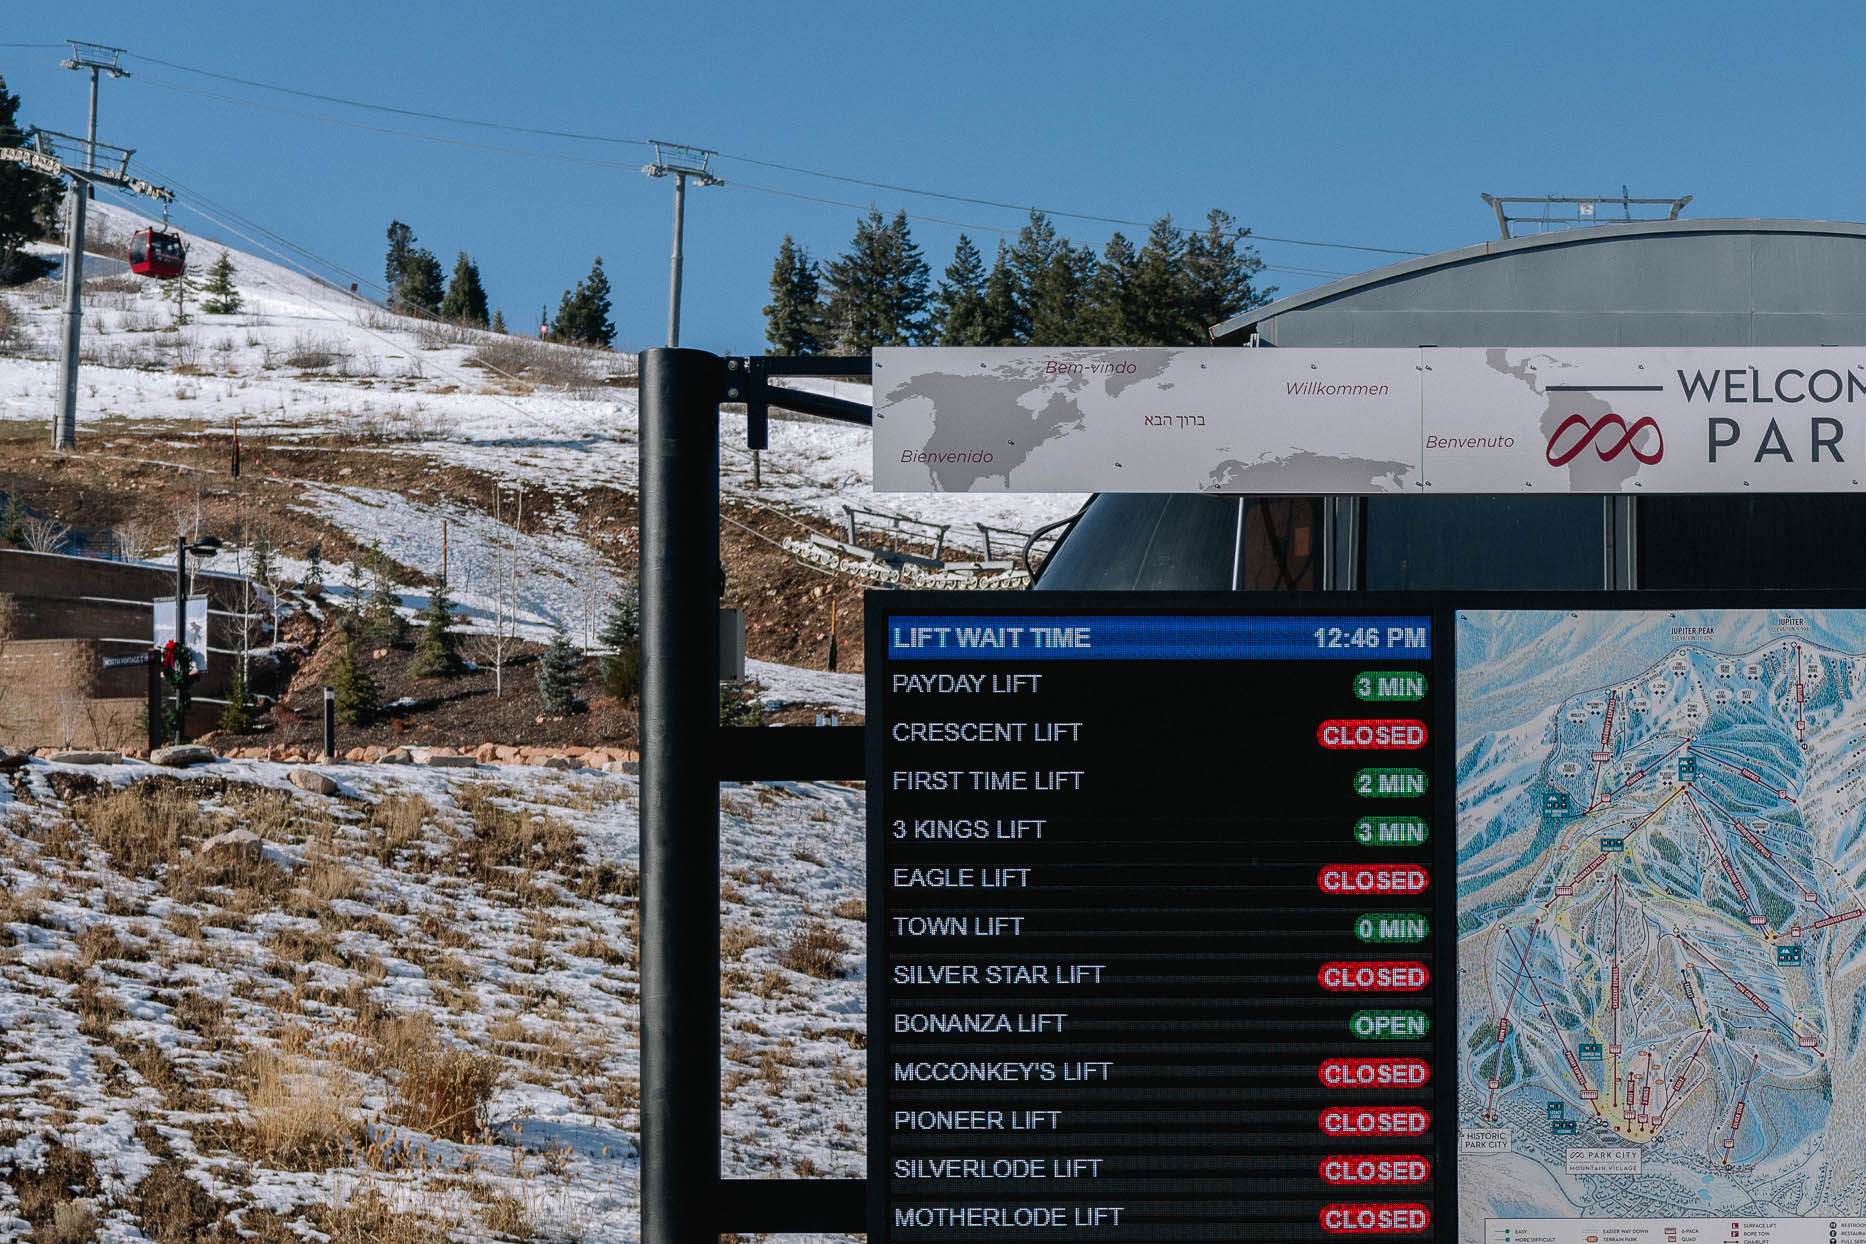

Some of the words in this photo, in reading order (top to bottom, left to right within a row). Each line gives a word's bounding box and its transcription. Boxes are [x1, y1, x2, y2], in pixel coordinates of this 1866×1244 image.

[1045, 360, 1137, 374] Bem-vindo
[1286, 381, 1389, 396] Willkommen
[1144, 414, 1172, 426] הבא
[1426, 434, 1515, 449] Benvenuto
[900, 450, 994, 464] Bienvenido
[894, 627, 949, 649] LIFT
[957, 627, 1022, 649] WAIT
[1030, 627, 1091, 649] TIME
[1314, 627, 1379, 649] 12:46
[1387, 627, 1427, 649] PM
[1671, 627, 1694, 635] JUPITER
[1697, 627, 1715, 635] PEAK
[893, 674, 986, 694] PAYDAY
[993, 674, 1042, 694] LIFT
[1358, 678, 1371, 698] 3
[1378, 678, 1424, 698] MIN
[892, 723, 1026, 743] CRESCENT
[1034, 723, 1082, 743] LIFT
[1324, 727, 1424, 746] CLOSED
[893, 771, 962, 790] FIRST
[969, 771, 1027, 790] TIME
[1035, 771, 1084, 790] LIFT
[1358, 775, 1372, 794] 2
[1379, 775, 1424, 794] MIN
[893, 820, 906, 840] 3
[915, 820, 989, 840] KINGS
[996, 820, 1046, 840] LIFT
[1358, 824, 1371, 843] 3
[1379, 824, 1424, 843] MIN
[894, 869, 974, 887] EAGLE
[981, 869, 1031, 887] LIFT
[1324, 873, 1424, 891] CLOSED
[893, 917, 967, 936] TOWN
[975, 917, 1024, 936] LIFT
[1359, 921, 1372, 940] 0
[1379, 921, 1424, 940] MIN
[894, 965, 979, 985] SILVER
[986, 965, 1048, 985] STAR
[1056, 965, 1106, 985] LIFT
[1324, 968, 1424, 987] CLOSED
[895, 1014, 1011, 1033] BONANZA
[1018, 1014, 1067, 1033] LIFT
[1356, 1017, 1425, 1035] OPEN
[895, 1063, 1055, 1082] MCCONKEY'S
[1063, 1063, 1113, 1082] LIFT
[1325, 1065, 1425, 1084] CLOSED
[895, 1111, 1004, 1130] PIONEER
[1011, 1111, 1061, 1130] LIFT
[1325, 1114, 1425, 1133] CLOSED
[895, 1160, 1046, 1179] SILVERLODE
[1054, 1160, 1103, 1179] LIFT
[1325, 1162, 1425, 1181] CLOSED
[896, 1208, 1067, 1227] MOTHERLODE
[1075, 1208, 1124, 1227] LIFT
[1325, 1210, 1426, 1229] CLOSED
